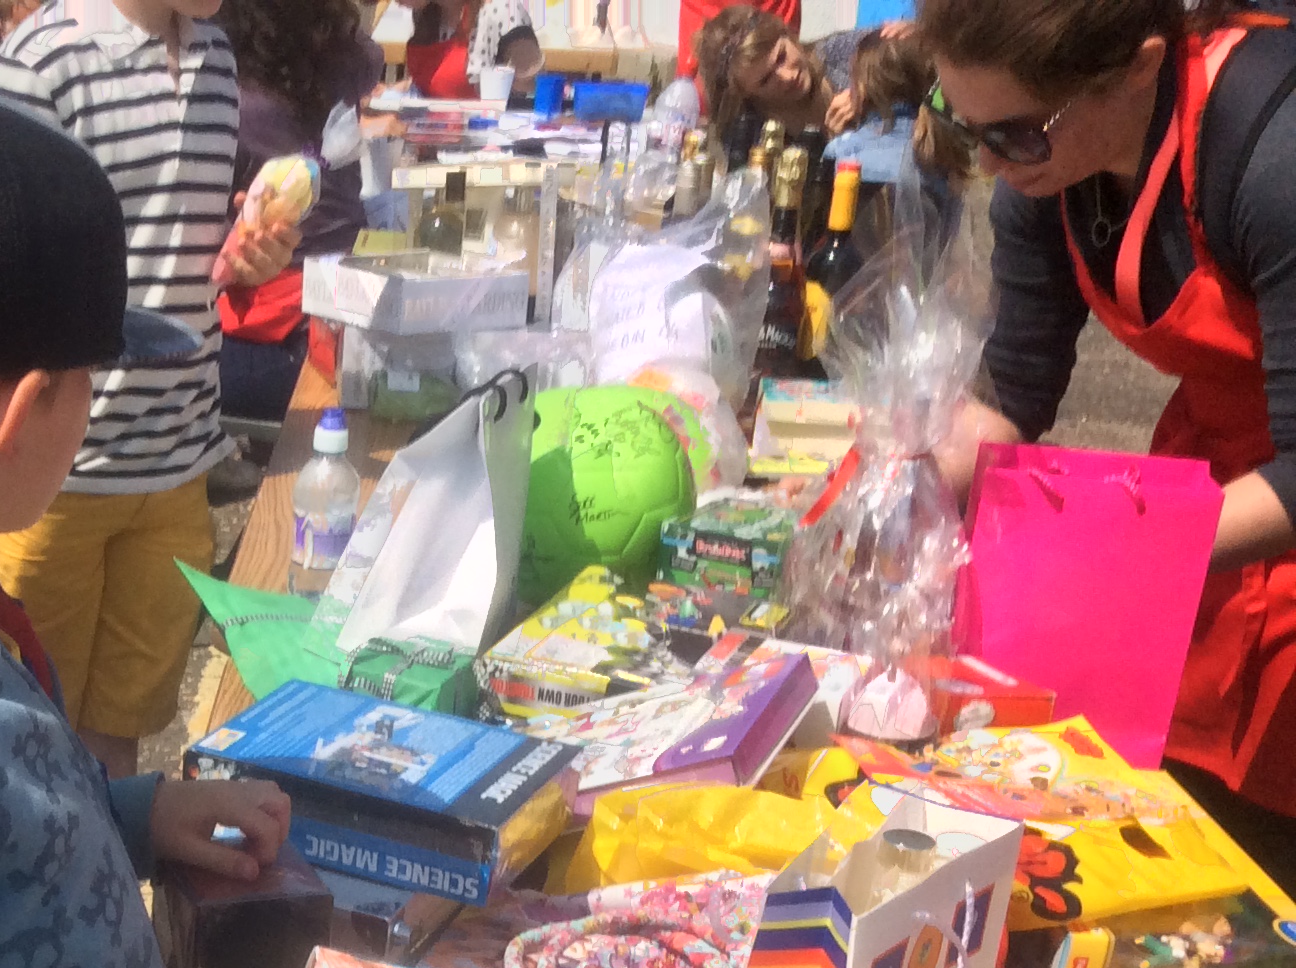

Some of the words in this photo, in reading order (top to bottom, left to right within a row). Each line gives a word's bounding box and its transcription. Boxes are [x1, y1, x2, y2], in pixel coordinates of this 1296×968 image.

[537, 687, 562, 706] OWN
[304, 834, 379, 873] MAGIC
[384, 855, 479, 899] SCIENCE
